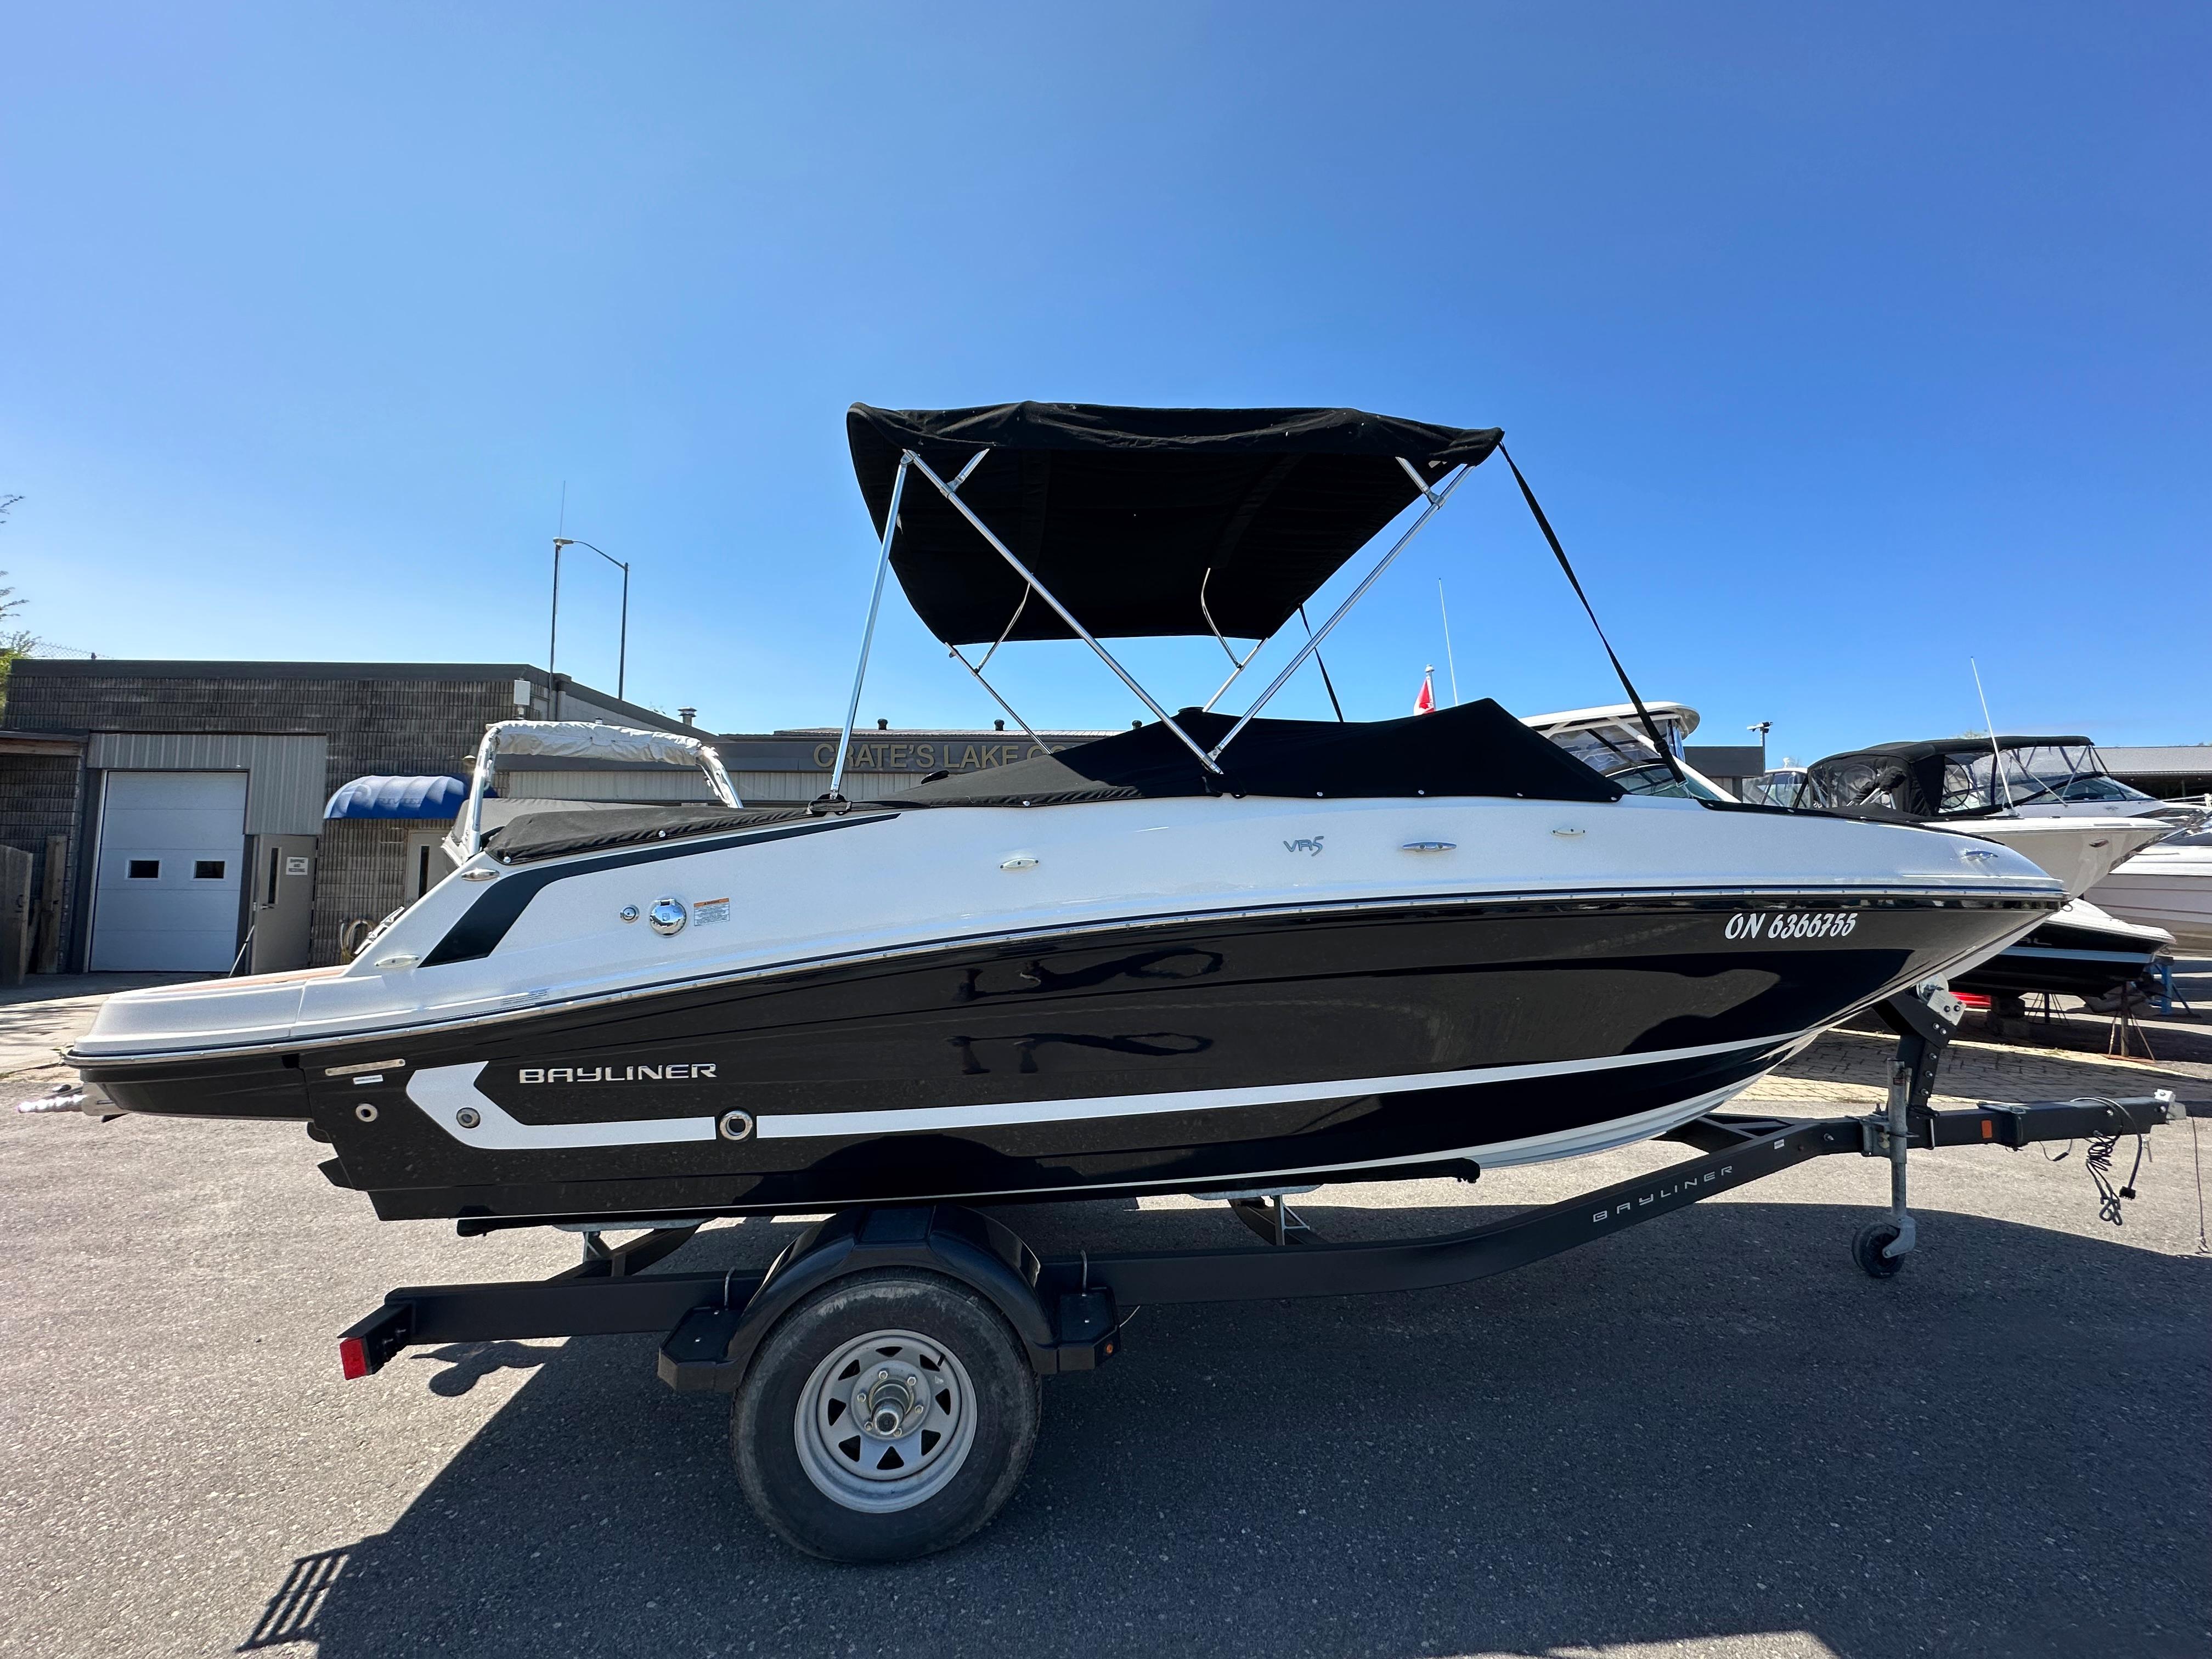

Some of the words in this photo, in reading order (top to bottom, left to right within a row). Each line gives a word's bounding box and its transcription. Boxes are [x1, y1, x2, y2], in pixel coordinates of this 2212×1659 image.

[814, 743, 935, 768] CRATE'S
[943, 745, 1019, 768] LAKE
[1725, 913, 1766, 939] ON
[1768, 913, 1858, 939] 6366755
[519, 1063, 717, 1084] BAYLINER
[1593, 1165, 1733, 1223] BAYLINER
